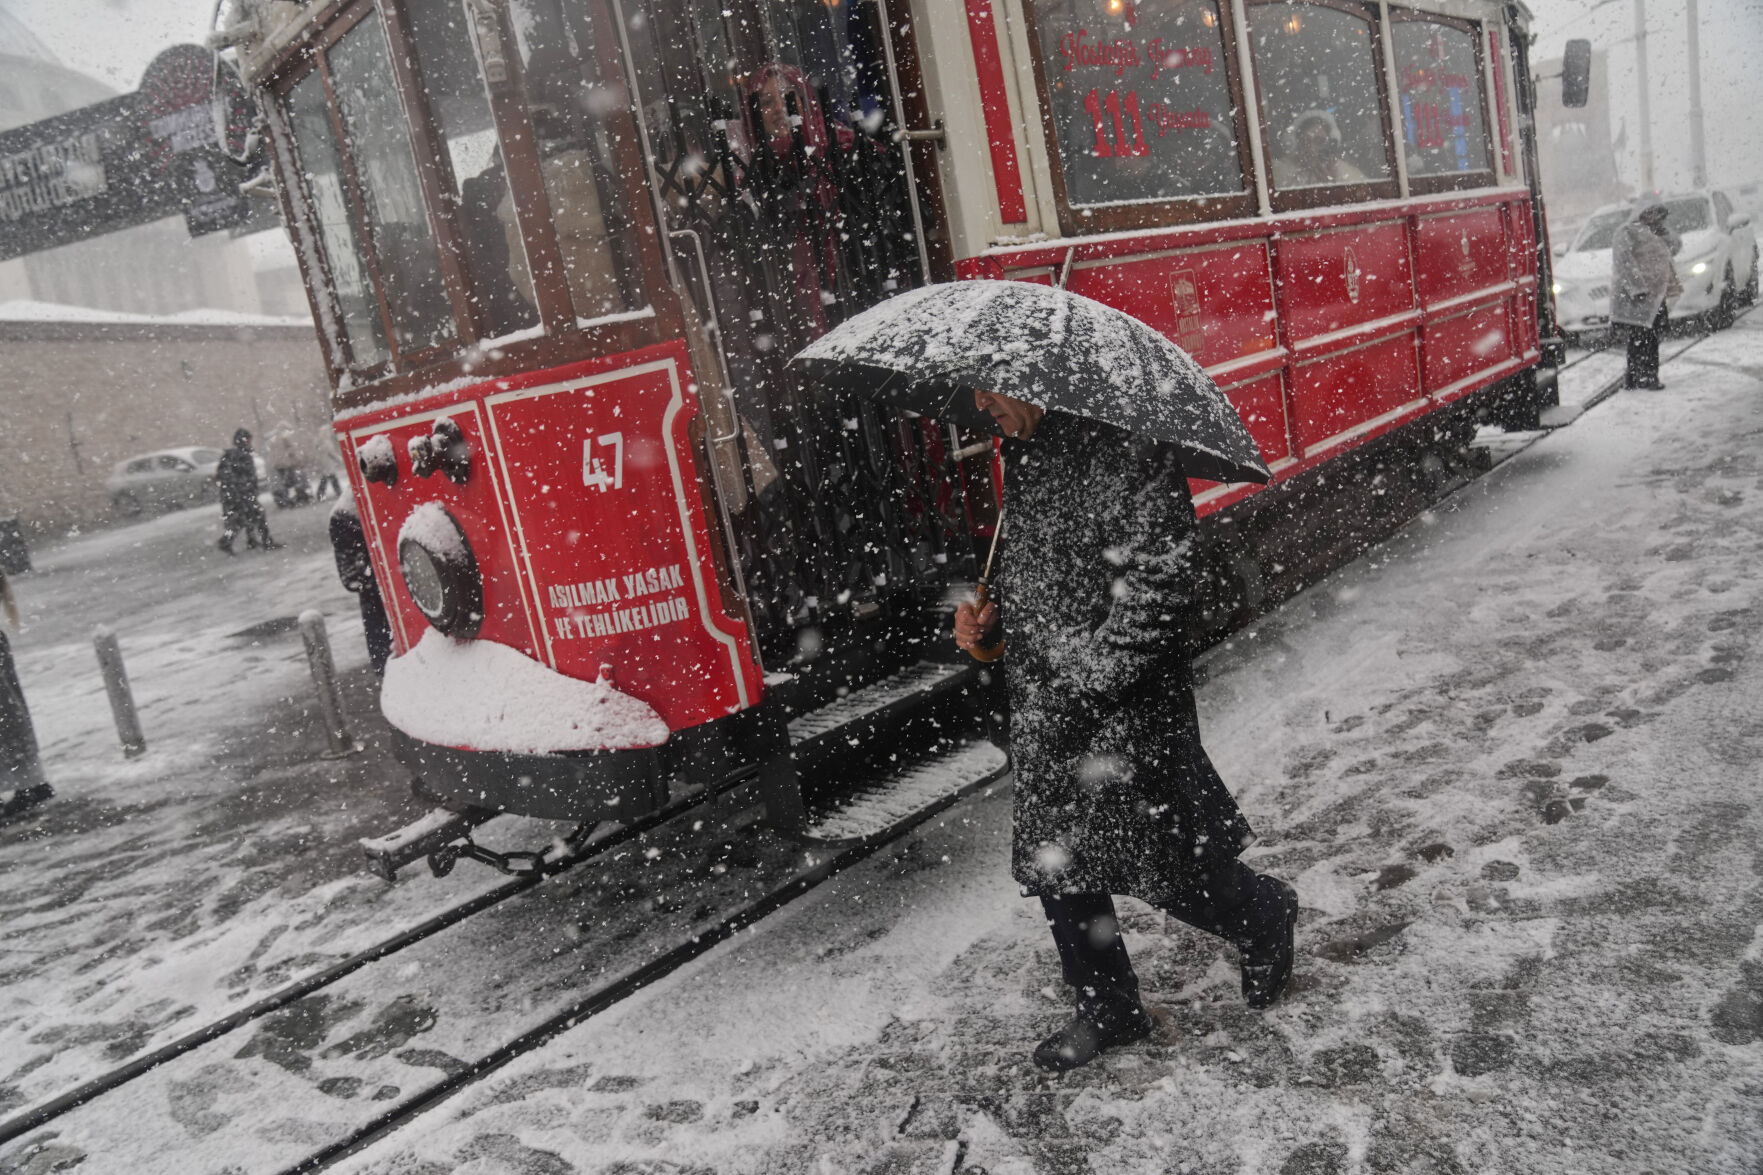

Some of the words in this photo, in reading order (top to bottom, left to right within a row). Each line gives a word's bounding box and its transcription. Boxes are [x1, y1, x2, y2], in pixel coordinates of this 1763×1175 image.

[1084, 88, 1150, 157] 111
[582, 431, 624, 493] 47
[548, 578, 621, 608] ASILMAK
[622, 564, 684, 599] YASAK
[554, 617, 574, 640] VE
[574, 595, 690, 638] TEHLİKELİDİR
